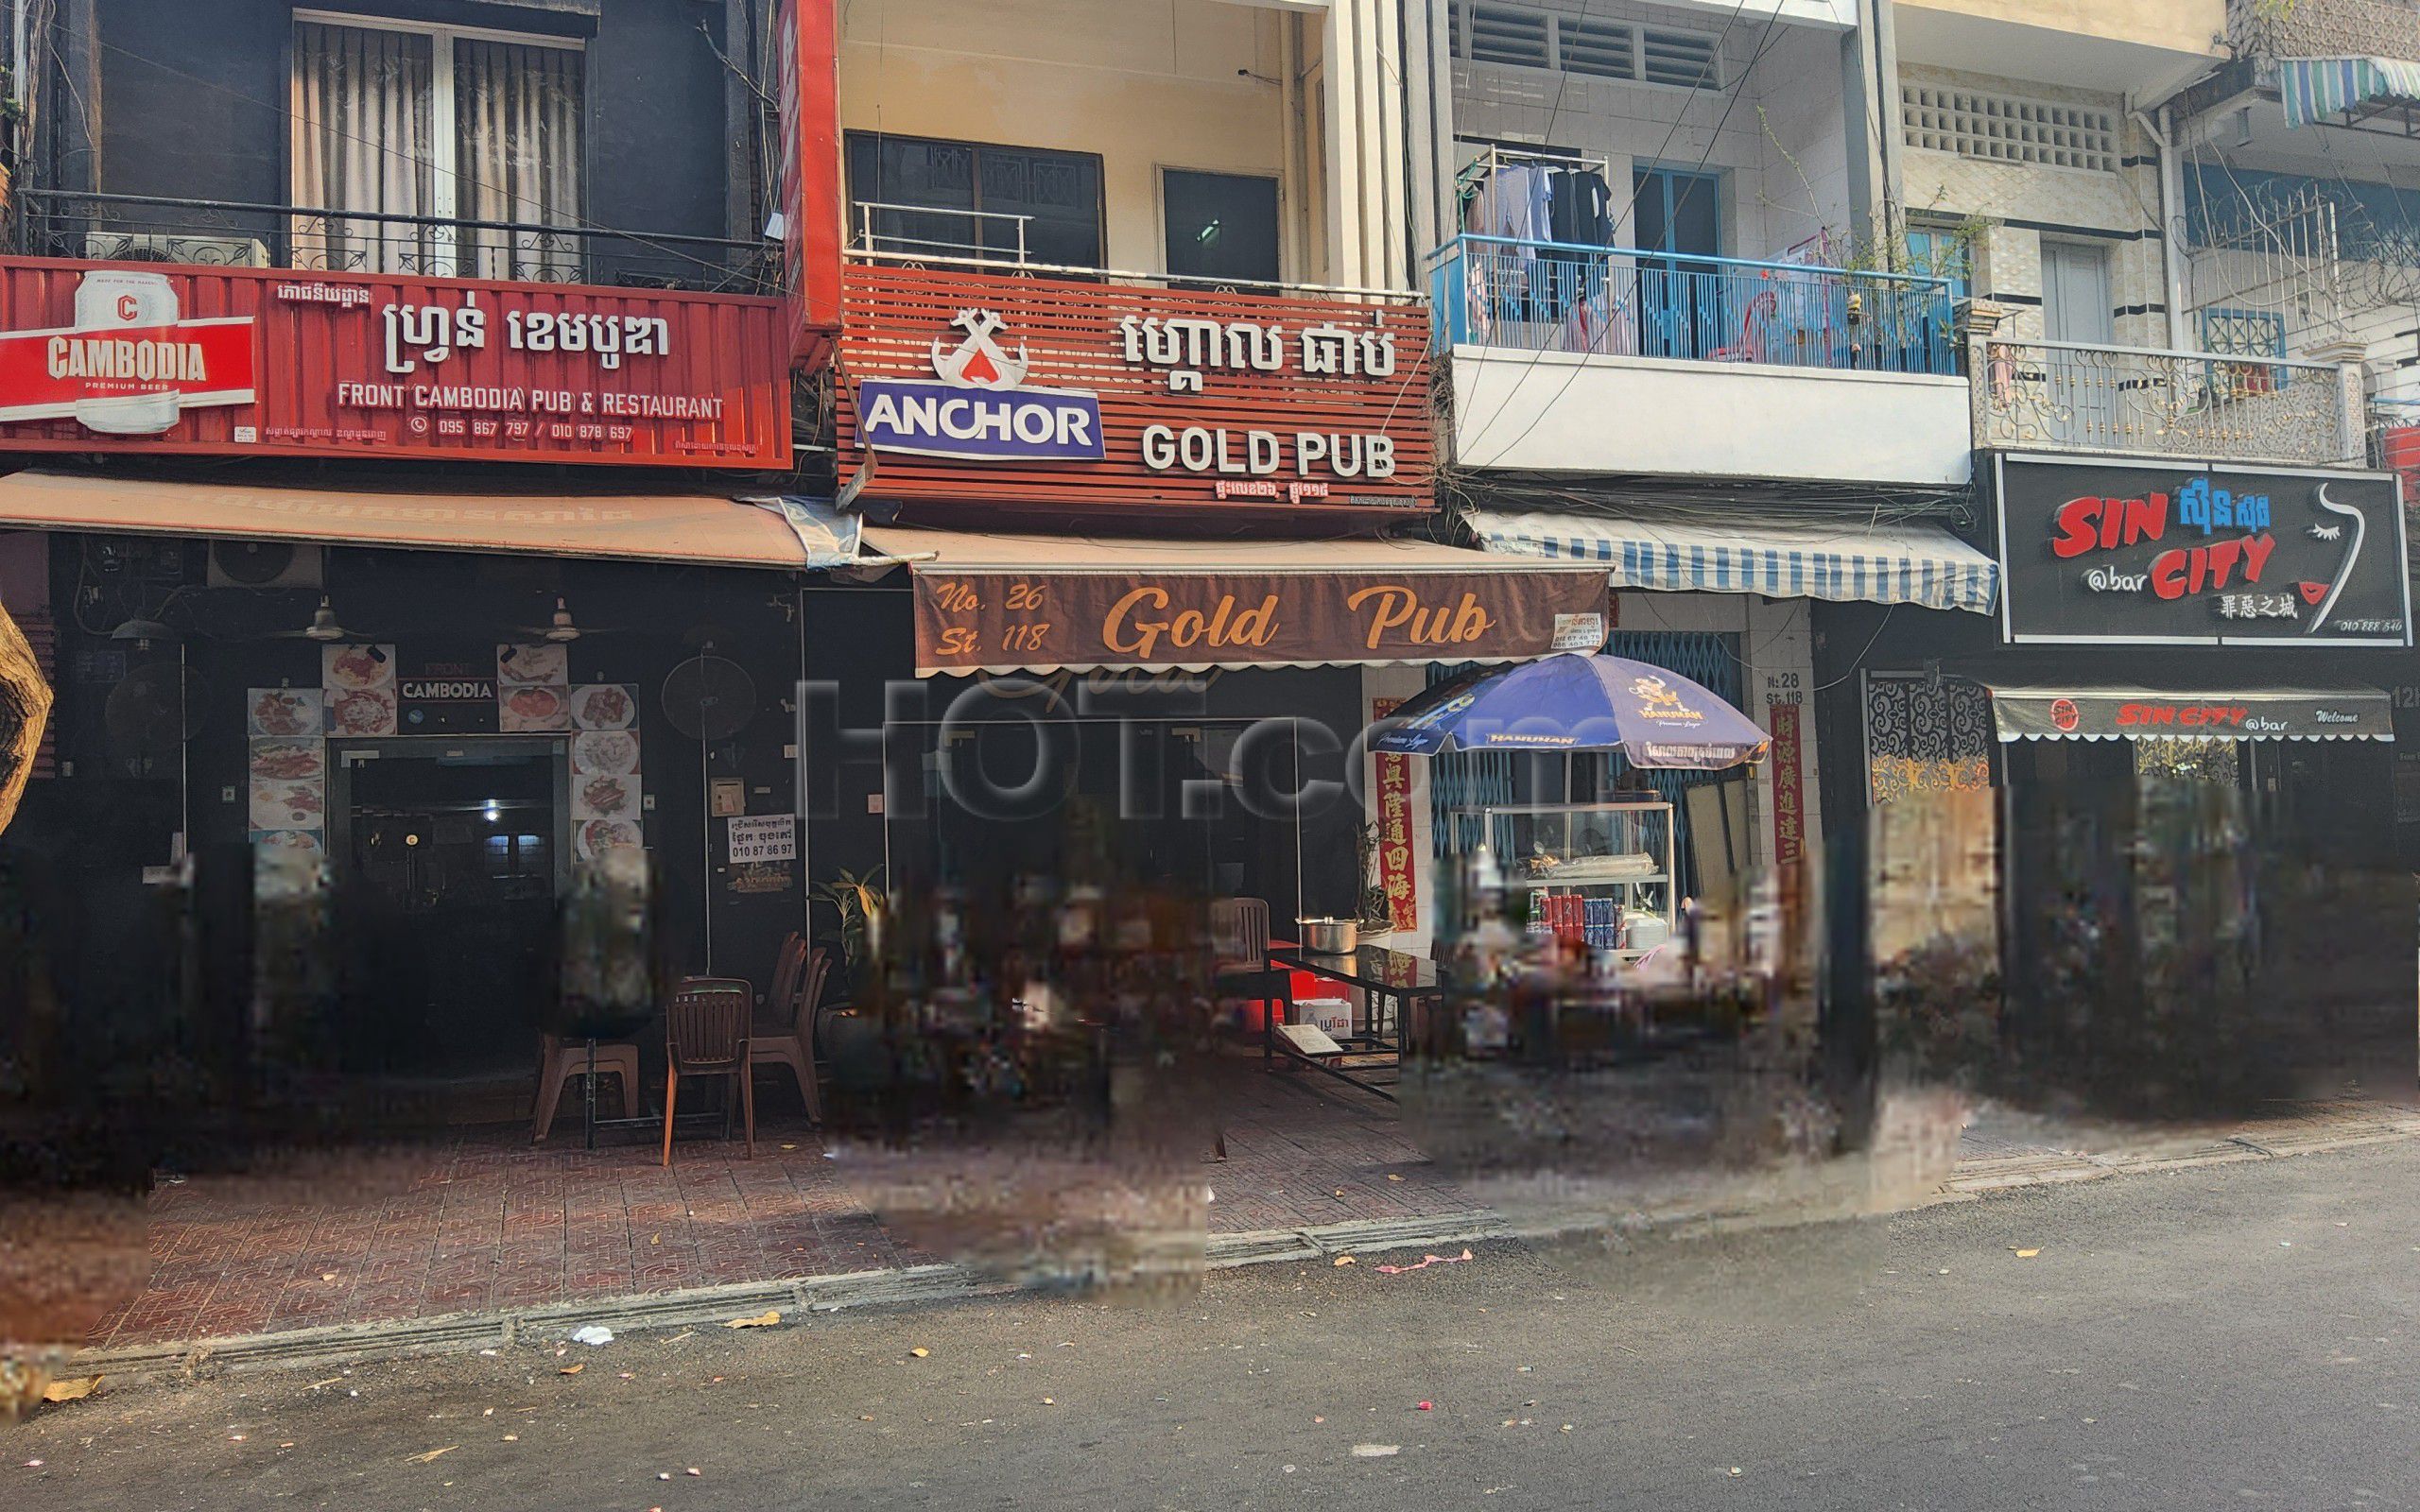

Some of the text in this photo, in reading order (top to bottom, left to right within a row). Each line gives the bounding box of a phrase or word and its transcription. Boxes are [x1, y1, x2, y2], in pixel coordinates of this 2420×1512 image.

[117, 294, 137, 321] C
[47, 335, 207, 382] CAMBODIA
[337, 383, 724, 419] FRONT CAMBODIA PUB & RESTAURANT
[440, 421, 464, 434] 095
[474, 421, 497, 435] 867
[506, 422, 529, 435] 797
[552, 424, 572, 438] 010
[579, 425, 603, 438] 878
[610, 426, 632, 439] 697
[865, 394, 1093, 446] ANCHOR
[1142, 424, 1396, 477] GOLD PUB
[2053, 491, 2169, 558] SIN
[2087, 565, 2148, 593] @bar
[2151, 534, 2275, 600] CITY
[936, 583, 1048, 614] No. 26
[2221, 593, 2299, 620] 罪惡之城
[1102, 585, 1496, 660] Gold Pub
[940, 623, 1051, 657] St. 118
[402, 681, 493, 699] CAMBODIA
[1638, 711, 1705, 720] HANUMAN
[2116, 703, 2289, 731] SIN CITY @bar
[2315, 709, 2360, 725] Welcome
[1490, 733, 1576, 745] HANUMAN
[733, 844, 792, 858] 010 87 86 97
